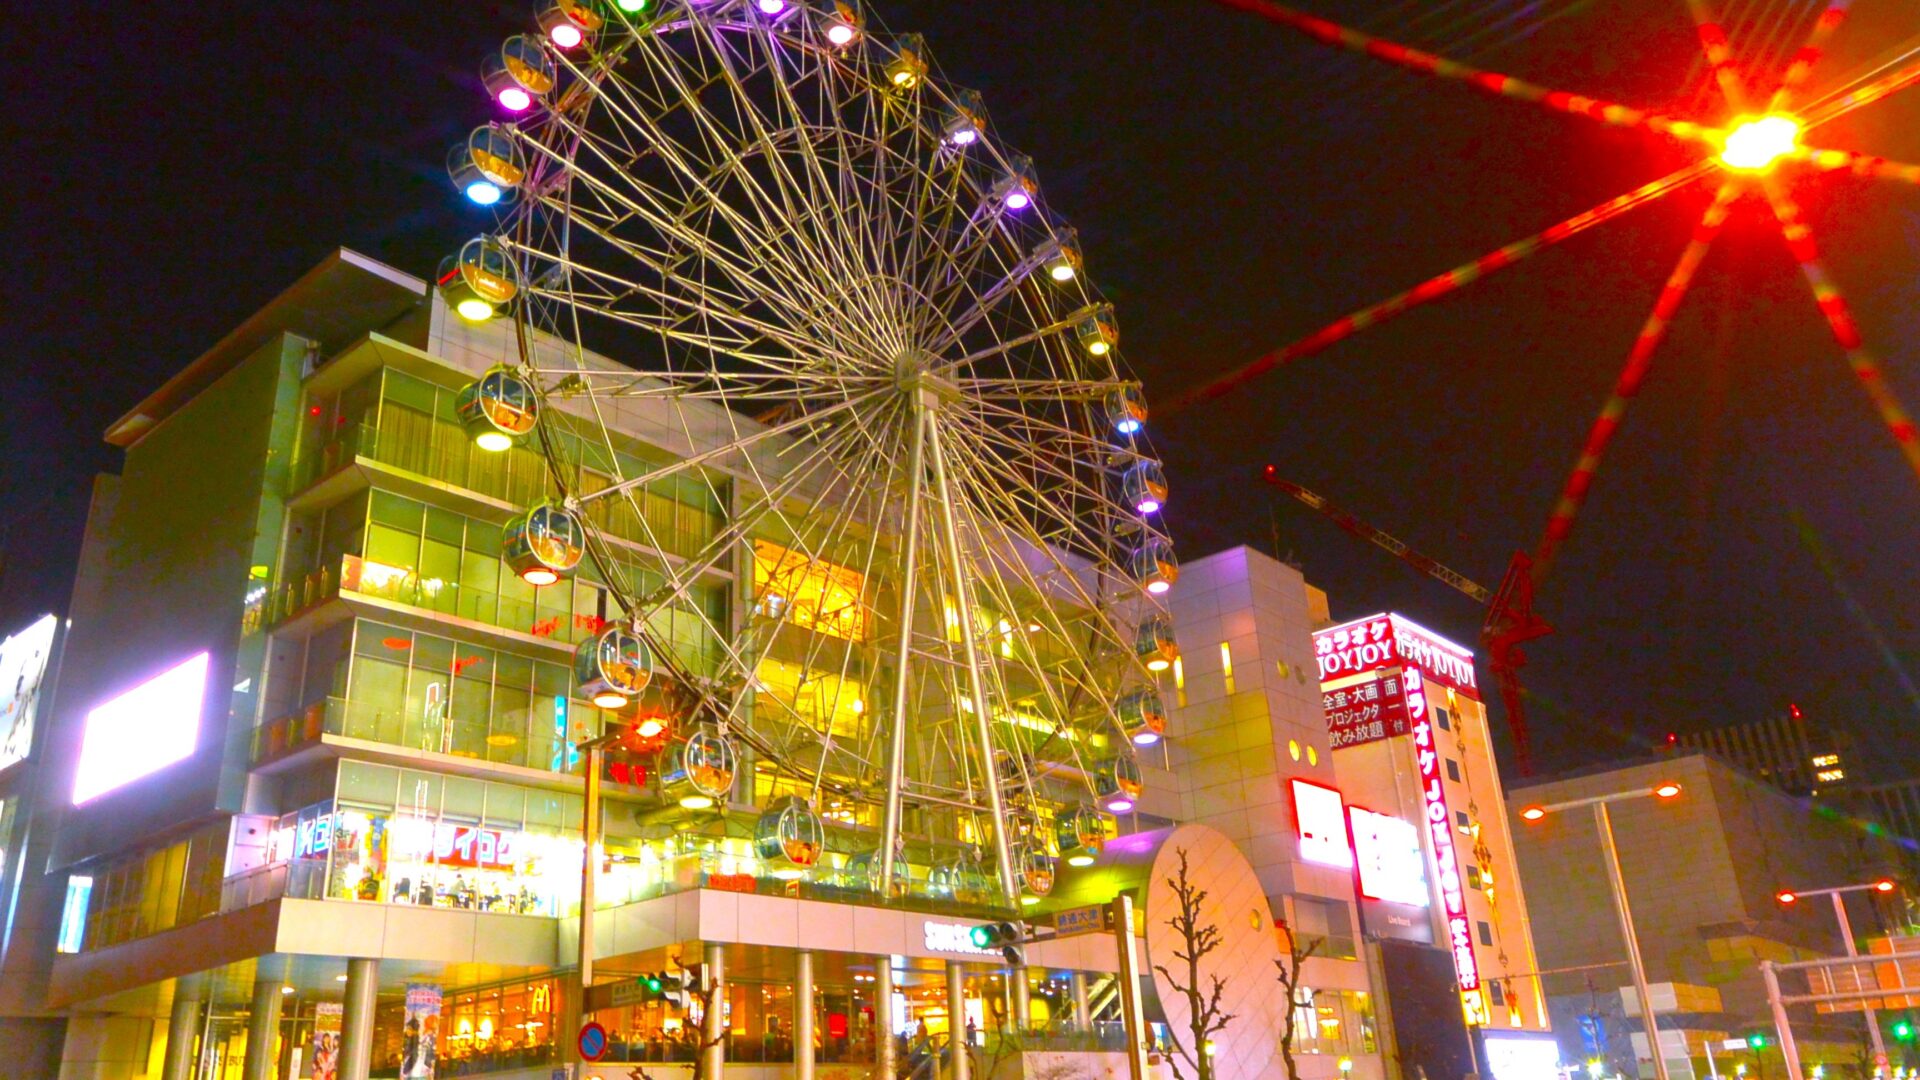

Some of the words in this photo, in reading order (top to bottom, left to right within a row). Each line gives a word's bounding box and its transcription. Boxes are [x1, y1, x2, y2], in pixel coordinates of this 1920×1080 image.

[1316, 621, 1388, 655] カラオケ
[1316, 639, 1392, 680] JOYJOY
[1431, 647, 1477, 689] JOYJOY
[1329, 719, 1404, 748] 飲み放題付
[1404, 665, 1437, 776] カラオケ
